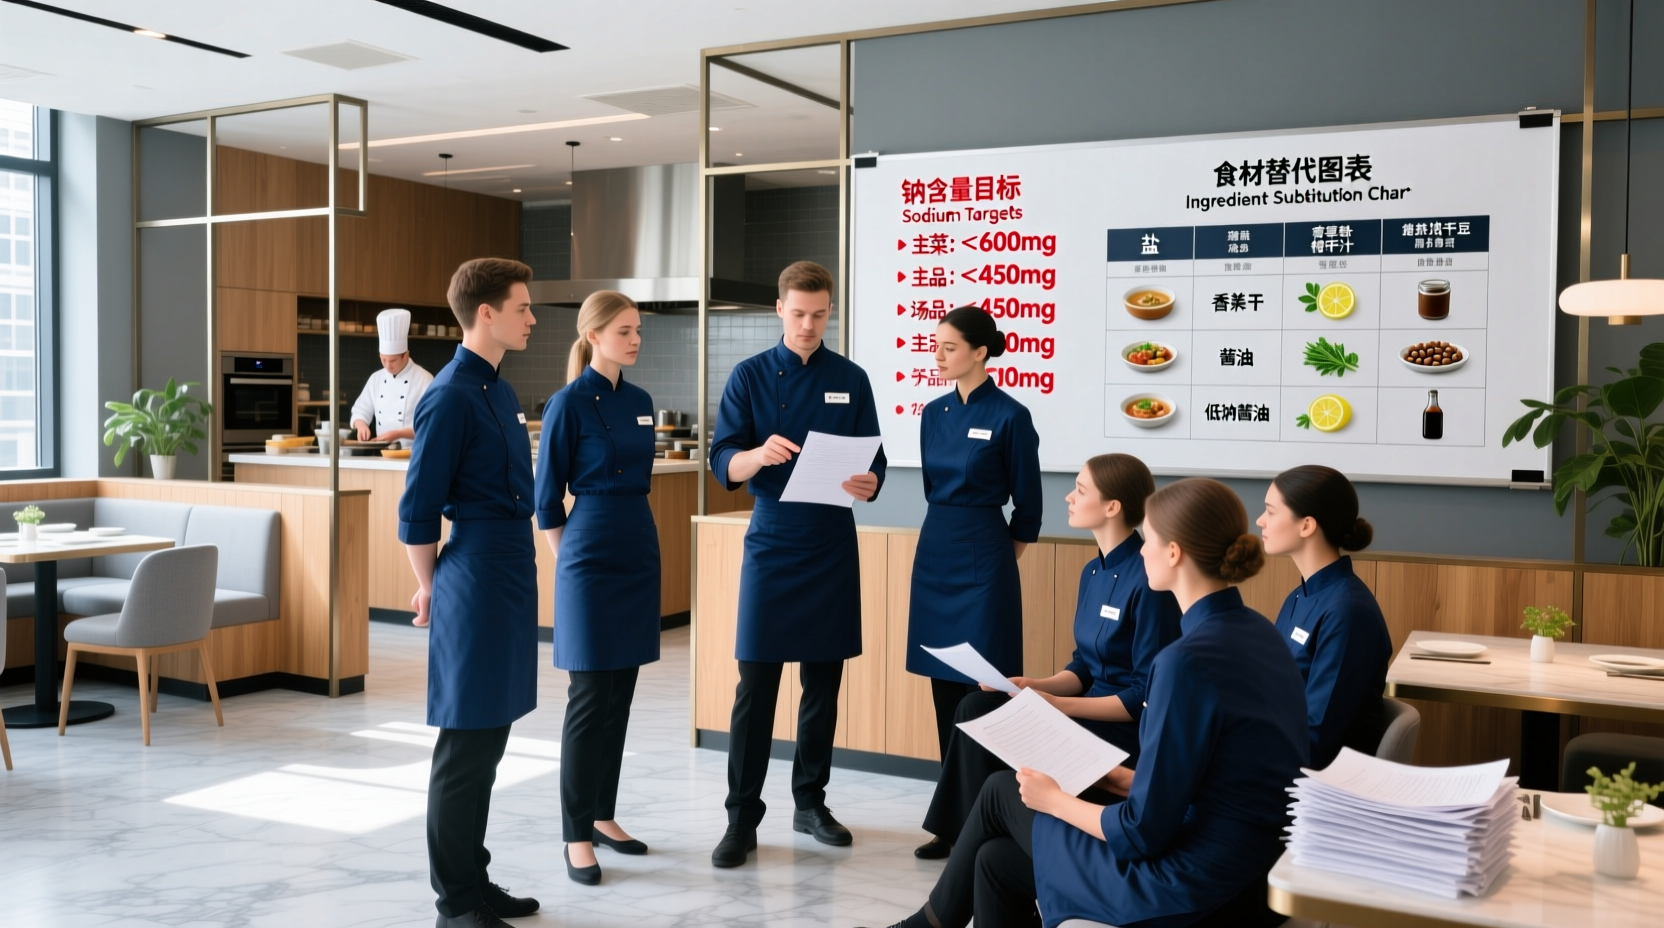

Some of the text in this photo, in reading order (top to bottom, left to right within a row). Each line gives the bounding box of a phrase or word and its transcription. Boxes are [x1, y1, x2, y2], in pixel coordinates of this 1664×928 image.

[1213, 153, 1372, 188] 食材替代图表
[901, 174, 1021, 205] 钠含量目标
[1186, 190, 1268, 212] Ingredient
[902, 205, 1023, 225] Sodium Targets
[961, 230, 1057, 257] <600mg
[1140, 232, 1160, 255] 盐
[961, 263, 1056, 290] <450mg
[1005, 331, 1055, 359] 0mg
